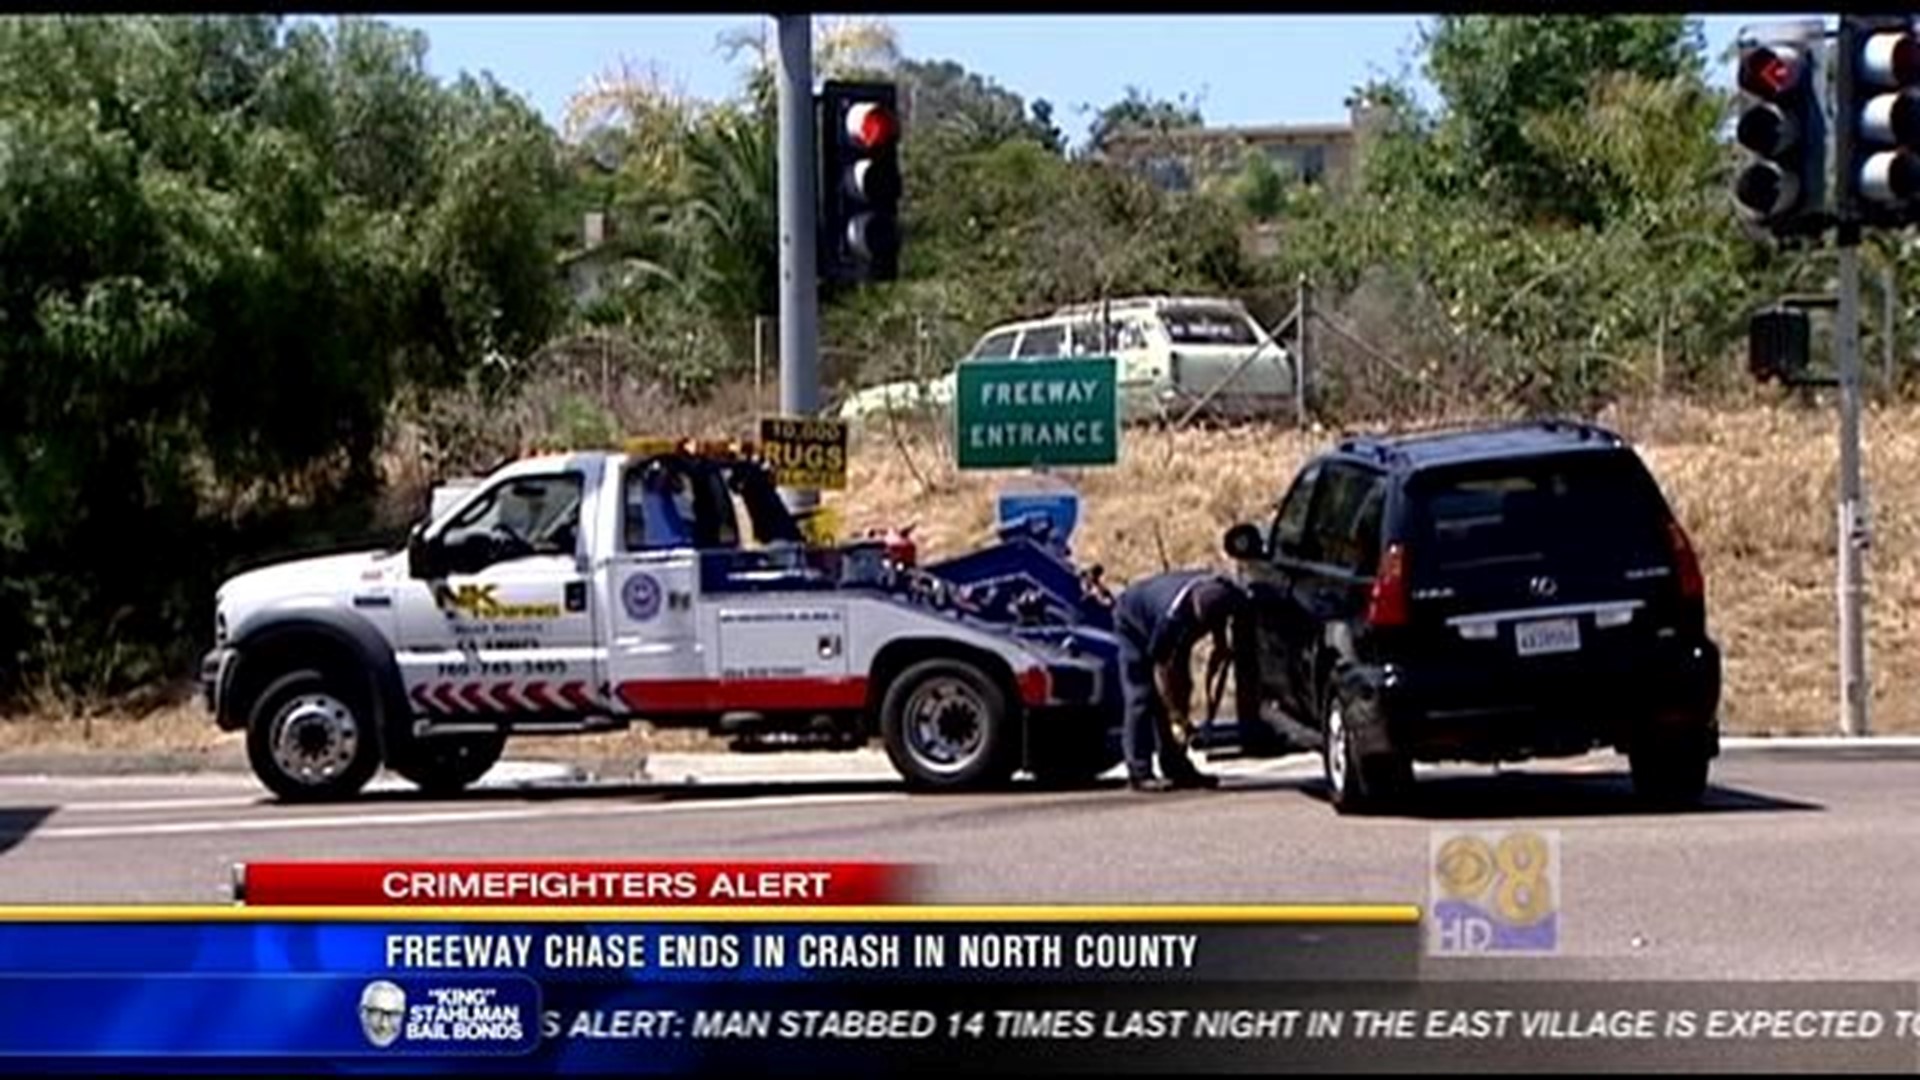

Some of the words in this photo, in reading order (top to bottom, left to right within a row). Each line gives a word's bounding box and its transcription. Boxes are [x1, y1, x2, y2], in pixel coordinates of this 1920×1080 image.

[981, 380, 1098, 405] FREEWAY
[970, 420, 1104, 448] ENTRANCE
[764, 440, 843, 470] RUGS
